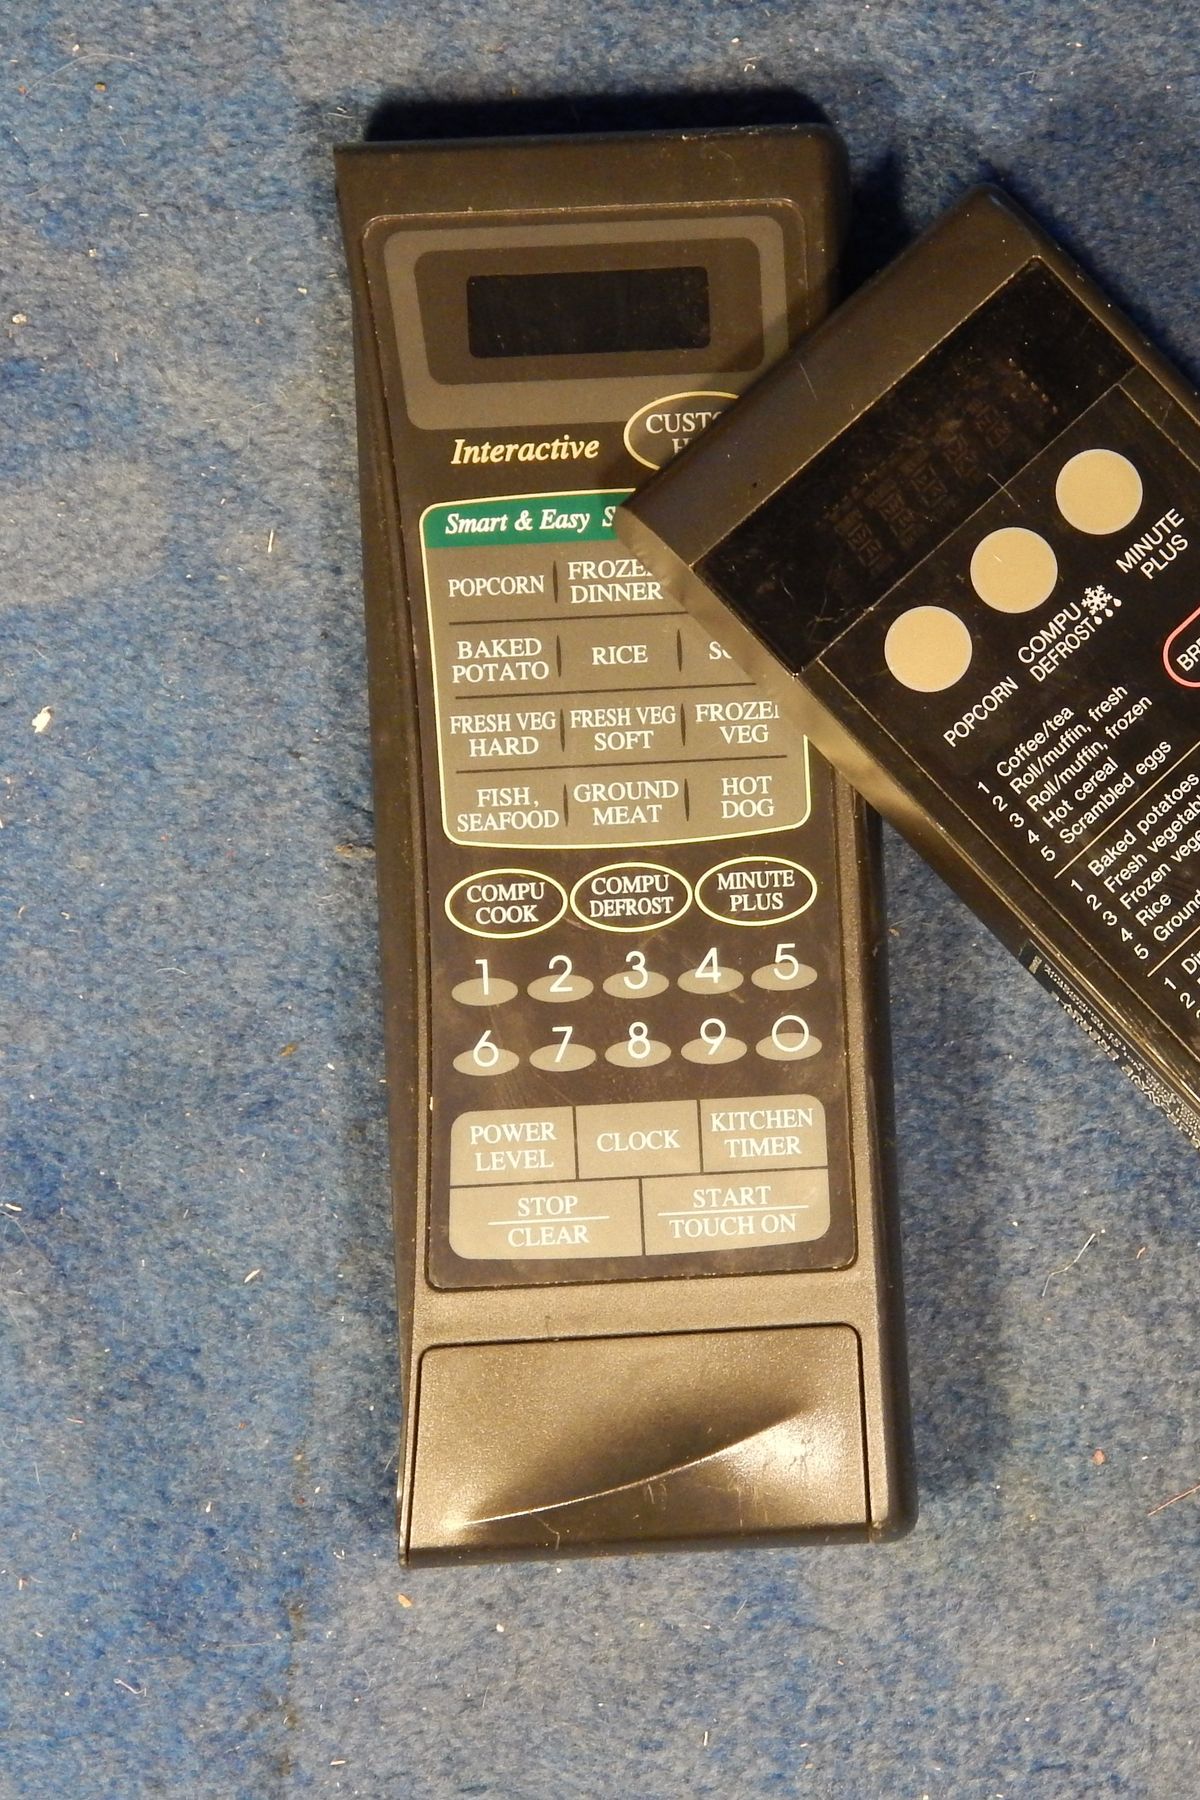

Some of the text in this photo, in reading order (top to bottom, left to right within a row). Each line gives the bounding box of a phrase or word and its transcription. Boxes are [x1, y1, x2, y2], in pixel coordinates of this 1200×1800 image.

[645, 411, 722, 434] CUST
[451, 435, 599, 464] Interactive
[445, 513, 508, 534] Smart
[514, 510, 533, 531] &
[539, 509, 590, 533] Easy
[1115, 508, 1184, 573] MINUTE
[1140, 534, 1188, 579] PLUS
[567, 559, 653, 580] FROZE
[448, 575, 544, 597] POPCORN
[570, 582, 663, 603] DINNER
[1018, 602, 1081, 663] COMPU
[457, 638, 542, 659] BAKED
[592, 645, 648, 665] RICE
[1029, 616, 1095, 681] DEFROST
[452, 661, 549, 683] POTATO
[570, 706, 676, 728] FRESH VEG
[943, 675, 1018, 746] POPCORN
[450, 712, 556, 734] FRESH VEG
[719, 725, 768, 743] VEG
[469, 737, 538, 757] HARD
[595, 731, 654, 751] SOFT
[978, 707, 1074, 793] 1 Coffee/tea
[992, 686, 1128, 811] 2 Roll/muffin, fresh
[1009, 696, 1152, 827] 3 Roll/muffin, frozen
[574, 780, 678, 802] GROUND
[722, 776, 772, 795] HOT
[721, 799, 774, 818] DOG
[1028, 756, 1118, 843] 4 Hot cereal
[1040, 741, 1171, 861] 5 Scrambled eggs
[458, 810, 559, 832] SEAFOOD
[593, 805, 662, 825] MEAT
[1070, 773, 1199, 891] 1 Baked potatoes
[591, 875, 669, 895] COMPU
[717, 870, 795, 890] MINUTE
[1086, 894, 1102, 910] 2
[1104, 853, 1147, 893] Fresh
[466, 882, 544, 902] COMPU
[730, 893, 783, 911] PLUS
[1103, 910, 1117, 925] 3
[1119, 863, 1171, 909] Frozen
[476, 905, 538, 924] COOK
[590, 897, 673, 917] DEFROST
[1121, 894, 1171, 941] 4 Rice
[1134, 943, 1149, 959] 5
[474, 944, 799, 995] 1 2 3 4 5
[1164, 977, 1176, 989] 1
[1180, 992, 1195, 1008] 2
[473, 1015, 809, 1067] 6 7 8 9 0
[712, 1109, 812, 1131] KITCHEN
[470, 1122, 556, 1144] POWER
[597, 1130, 680, 1152] CLOCK
[725, 1136, 801, 1157] TIMER
[476, 1149, 553, 1171] LEVEL
[518, 1196, 577, 1216] STOP
[694, 1186, 771, 1207] START
[507, 1226, 588, 1246] CLEAR
[669, 1214, 795, 1236] TOUCH ON
